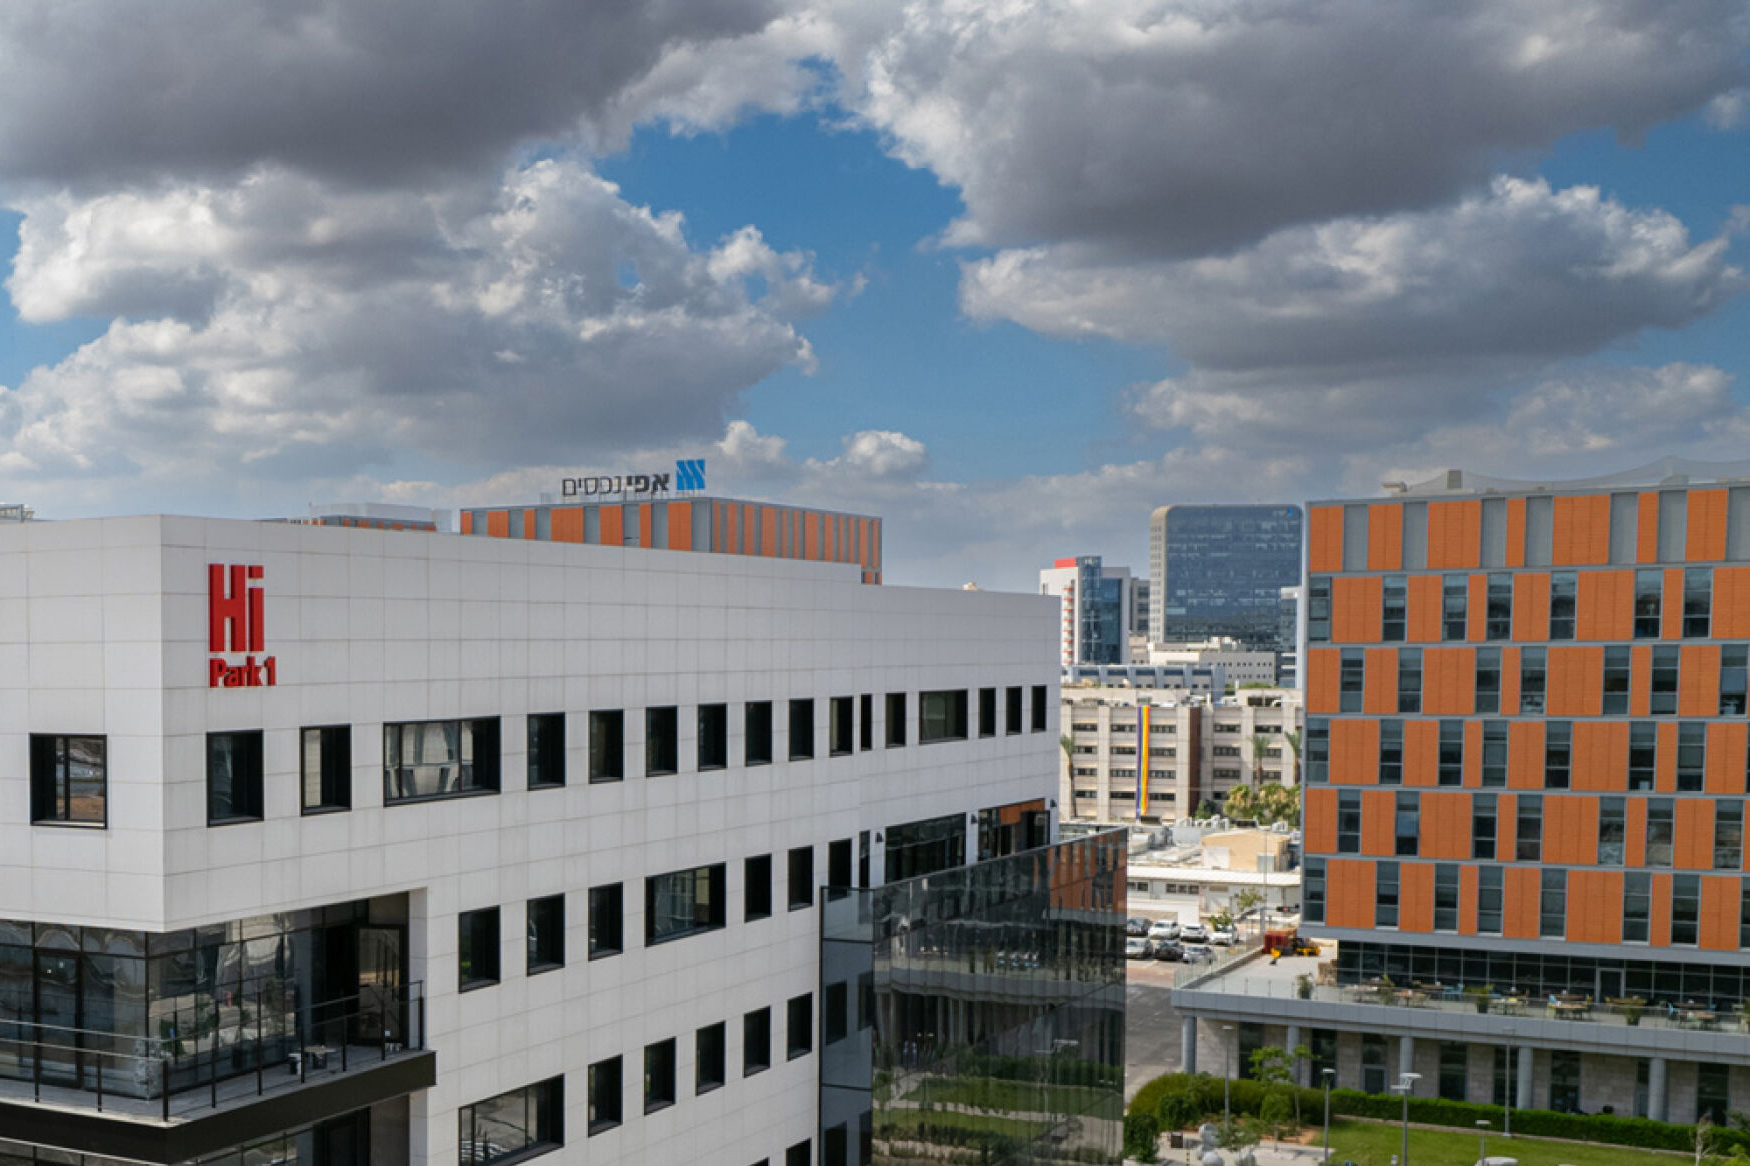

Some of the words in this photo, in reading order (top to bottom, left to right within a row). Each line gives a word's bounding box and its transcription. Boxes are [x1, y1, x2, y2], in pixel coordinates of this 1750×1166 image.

[208, 563, 265, 653] Hi
[209, 656, 262, 688] Park
[264, 656, 277, 686] 1
